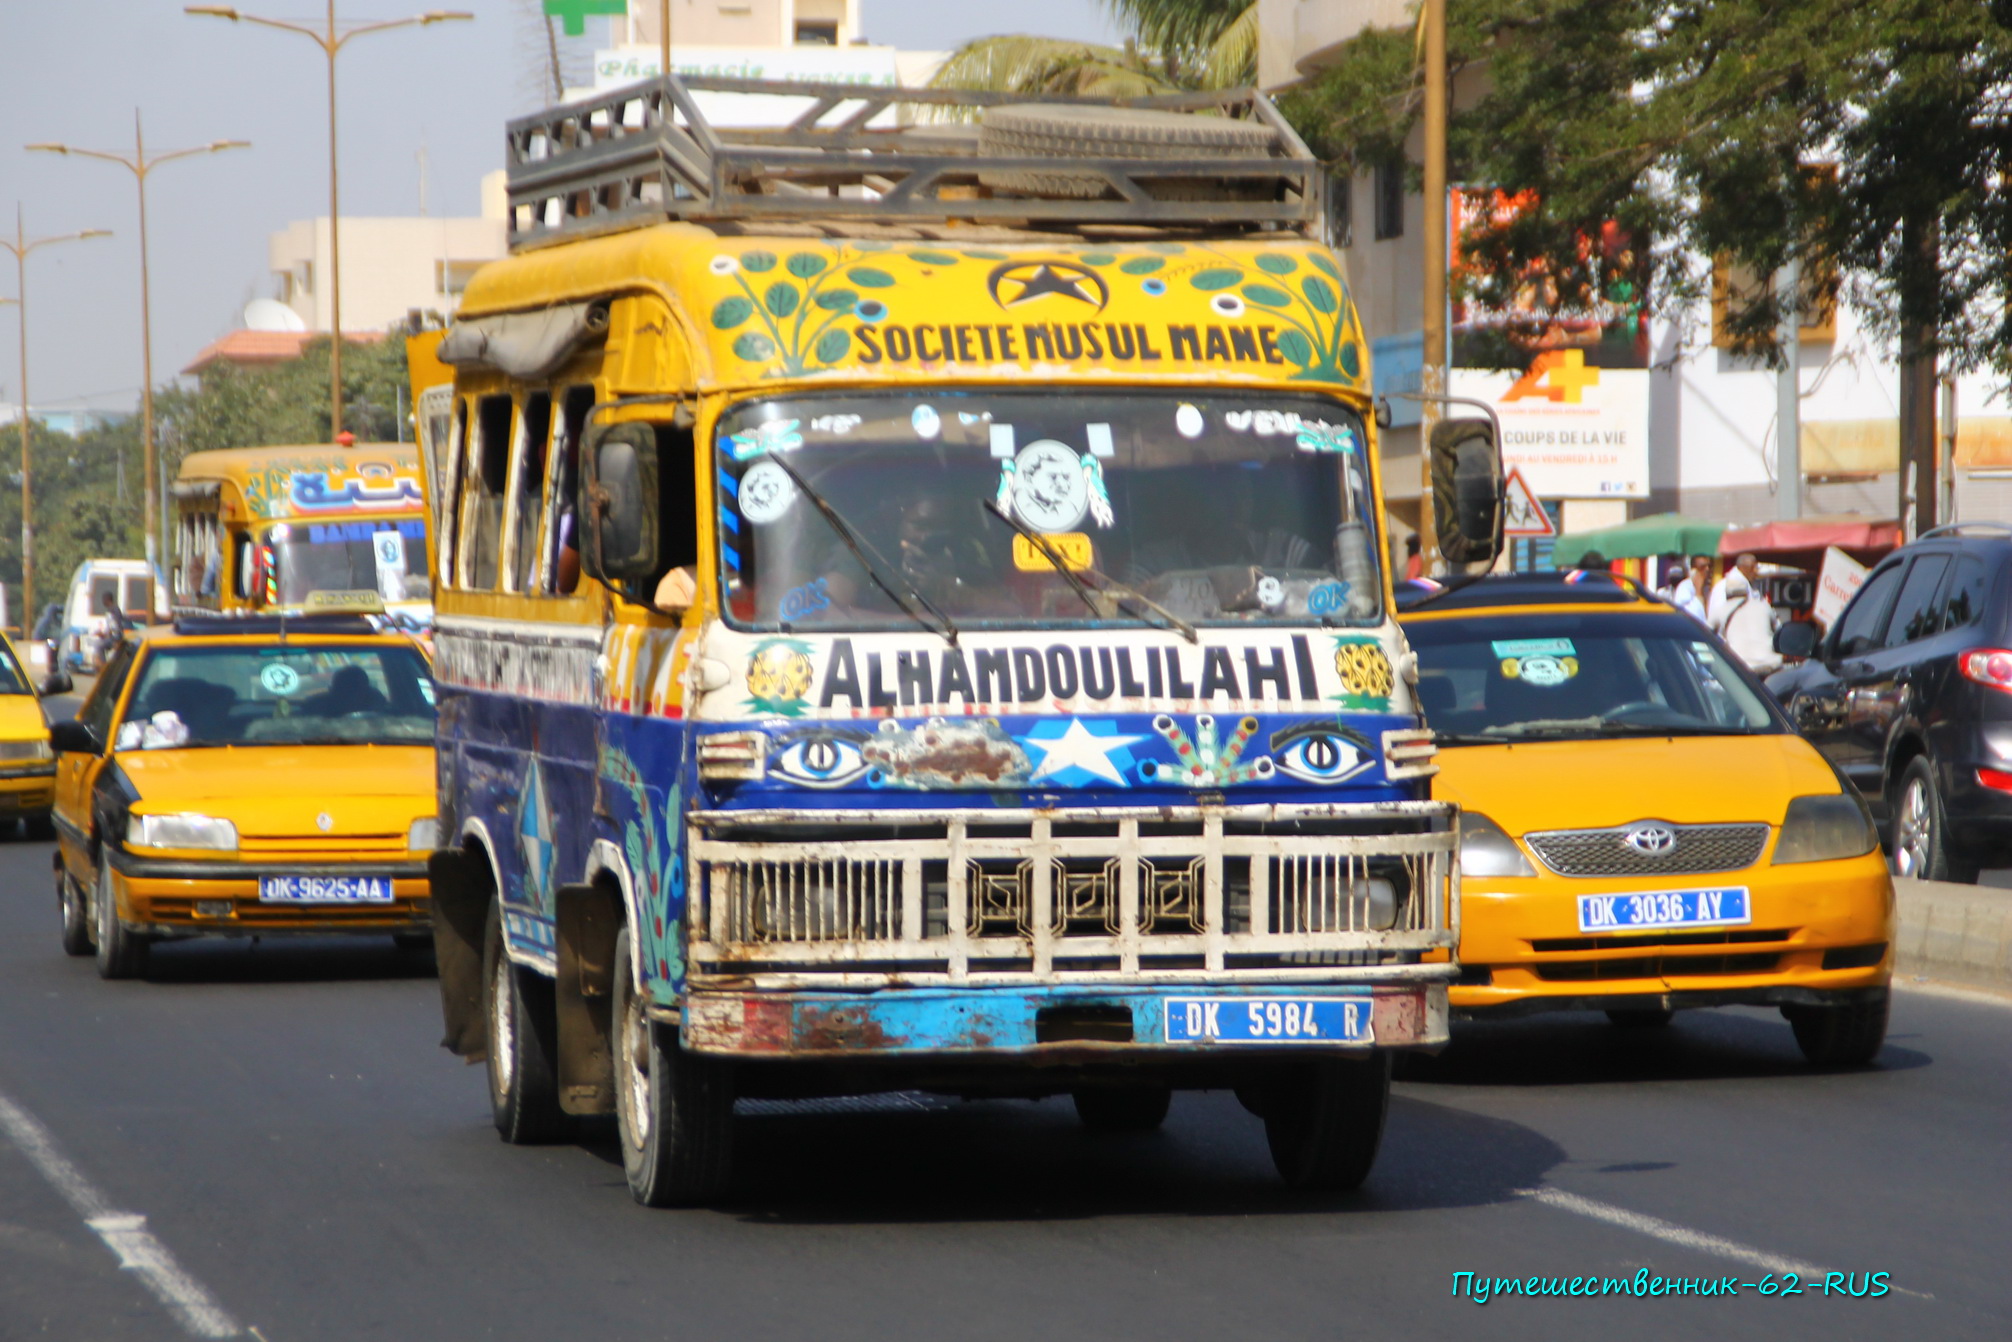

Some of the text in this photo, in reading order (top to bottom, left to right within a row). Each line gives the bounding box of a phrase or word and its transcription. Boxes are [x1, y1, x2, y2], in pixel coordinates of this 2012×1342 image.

[855, 323, 1018, 363] SOCIETE
[1504, 431, 1627, 445] COUPS DE LA VIE
[1503, 454, 1524, 465] UNDI
[1542, 454, 1586, 464] VENDREDI
[780, 577, 830, 620] OK
[1308, 581, 1351, 616] OK
[820, 634, 1321, 708] ALHAMDOULILAHI
[1590, 891, 1723, 926] DK 3036 AY
[1187, 1002, 1358, 1036] DK 5984 R
